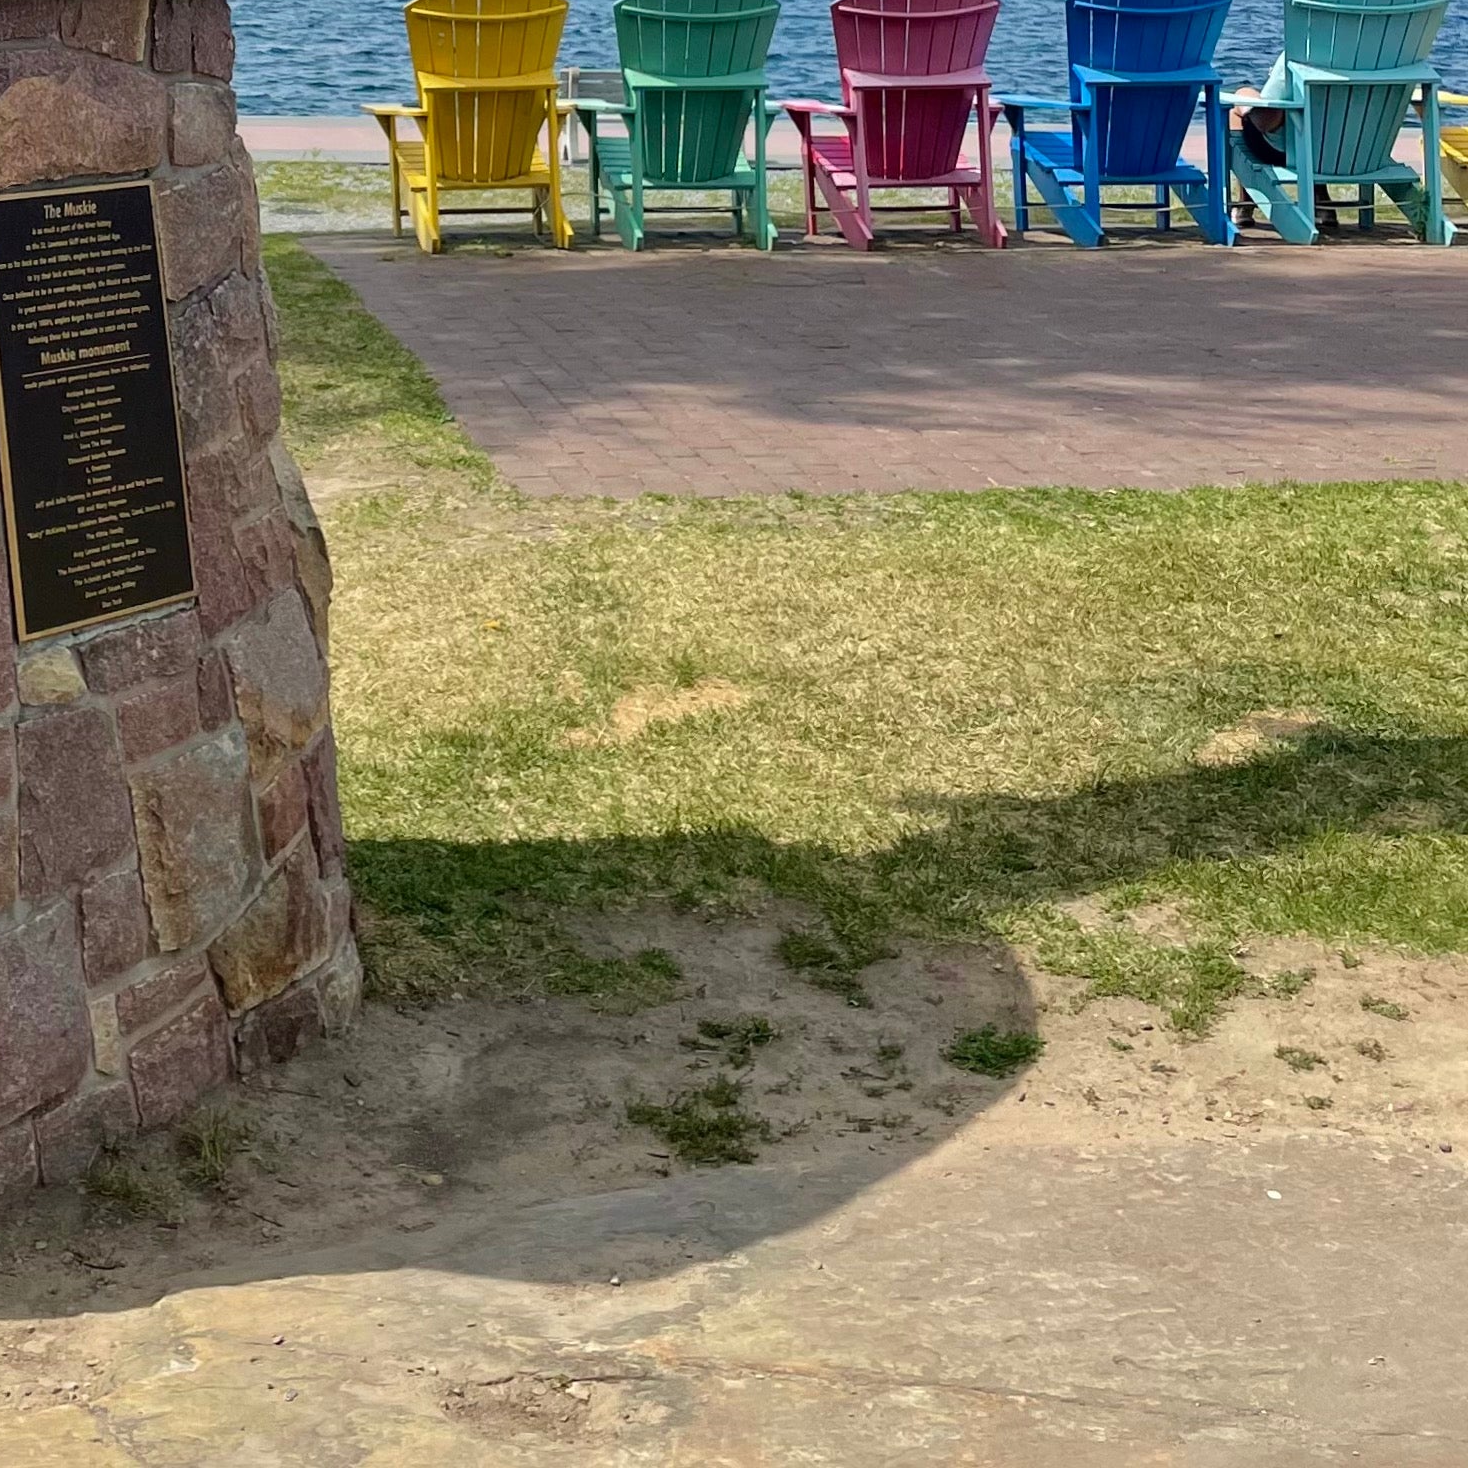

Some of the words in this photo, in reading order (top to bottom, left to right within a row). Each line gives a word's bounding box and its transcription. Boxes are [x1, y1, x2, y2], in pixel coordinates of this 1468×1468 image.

[43, 203, 62, 219] The
[64, 200, 97, 217] Muskie
[40, 348, 76, 365] Muskie
[78, 340, 130, 359] monument
